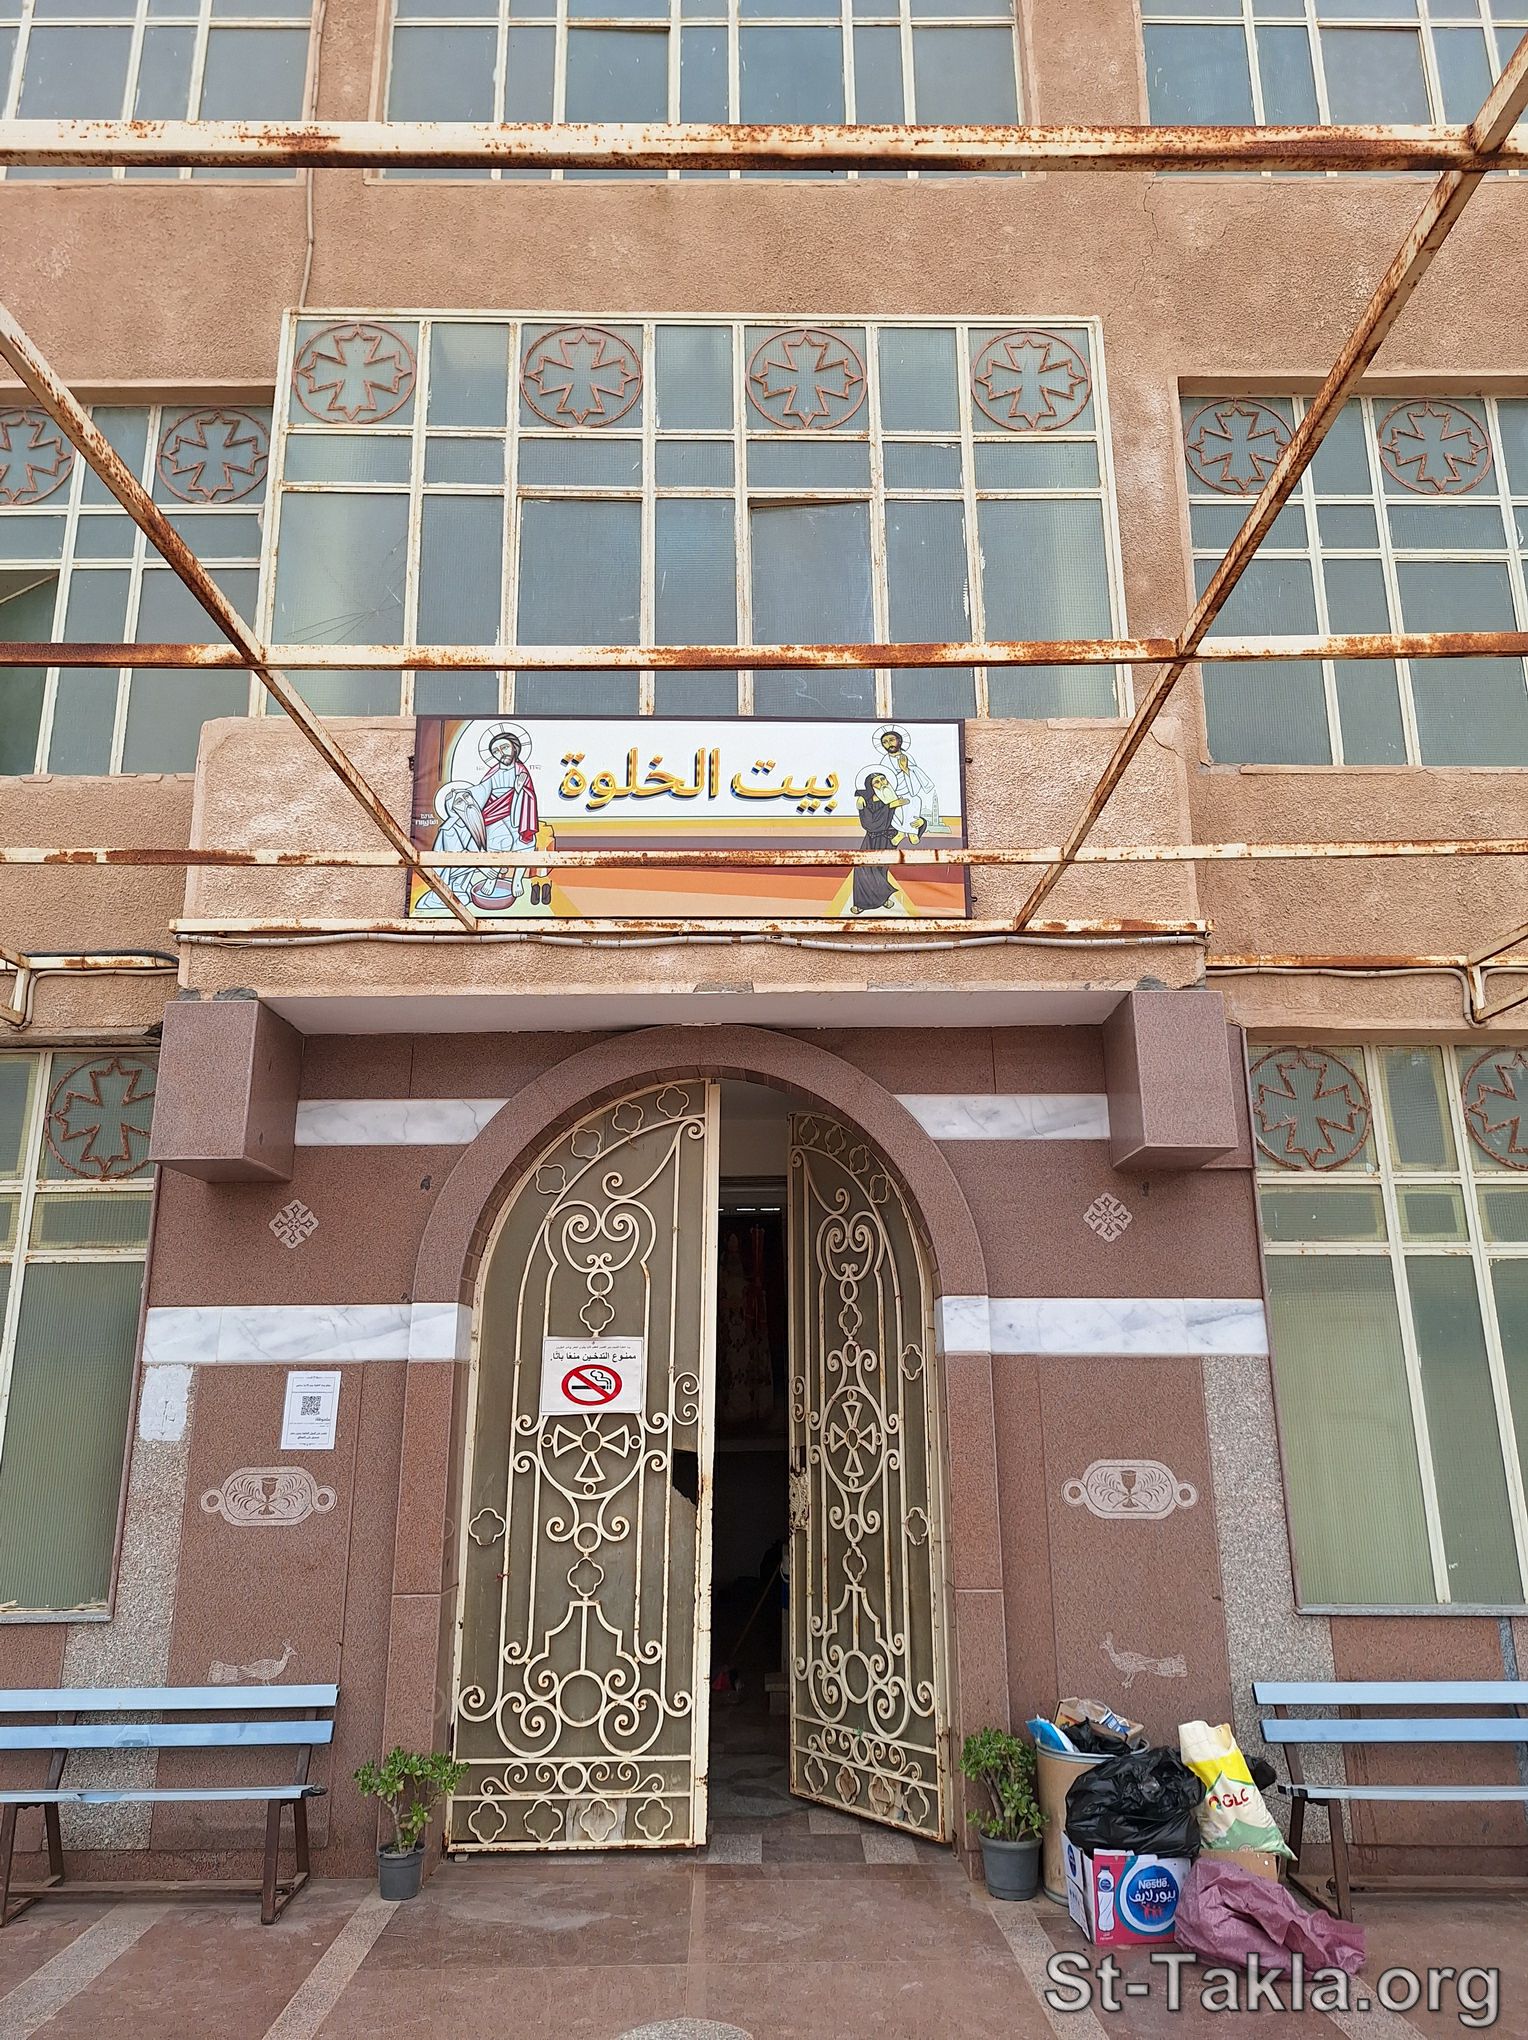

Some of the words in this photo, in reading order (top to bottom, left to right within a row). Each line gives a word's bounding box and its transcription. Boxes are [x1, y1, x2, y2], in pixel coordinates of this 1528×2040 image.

[558, 746, 720, 813] الخلوة
[730, 759, 840, 815] بيت
[582, 1352, 609, 1362] التدخين
[611, 1352, 637, 1362] ممنوع
[1222, 1788, 1249, 1807] GLC
